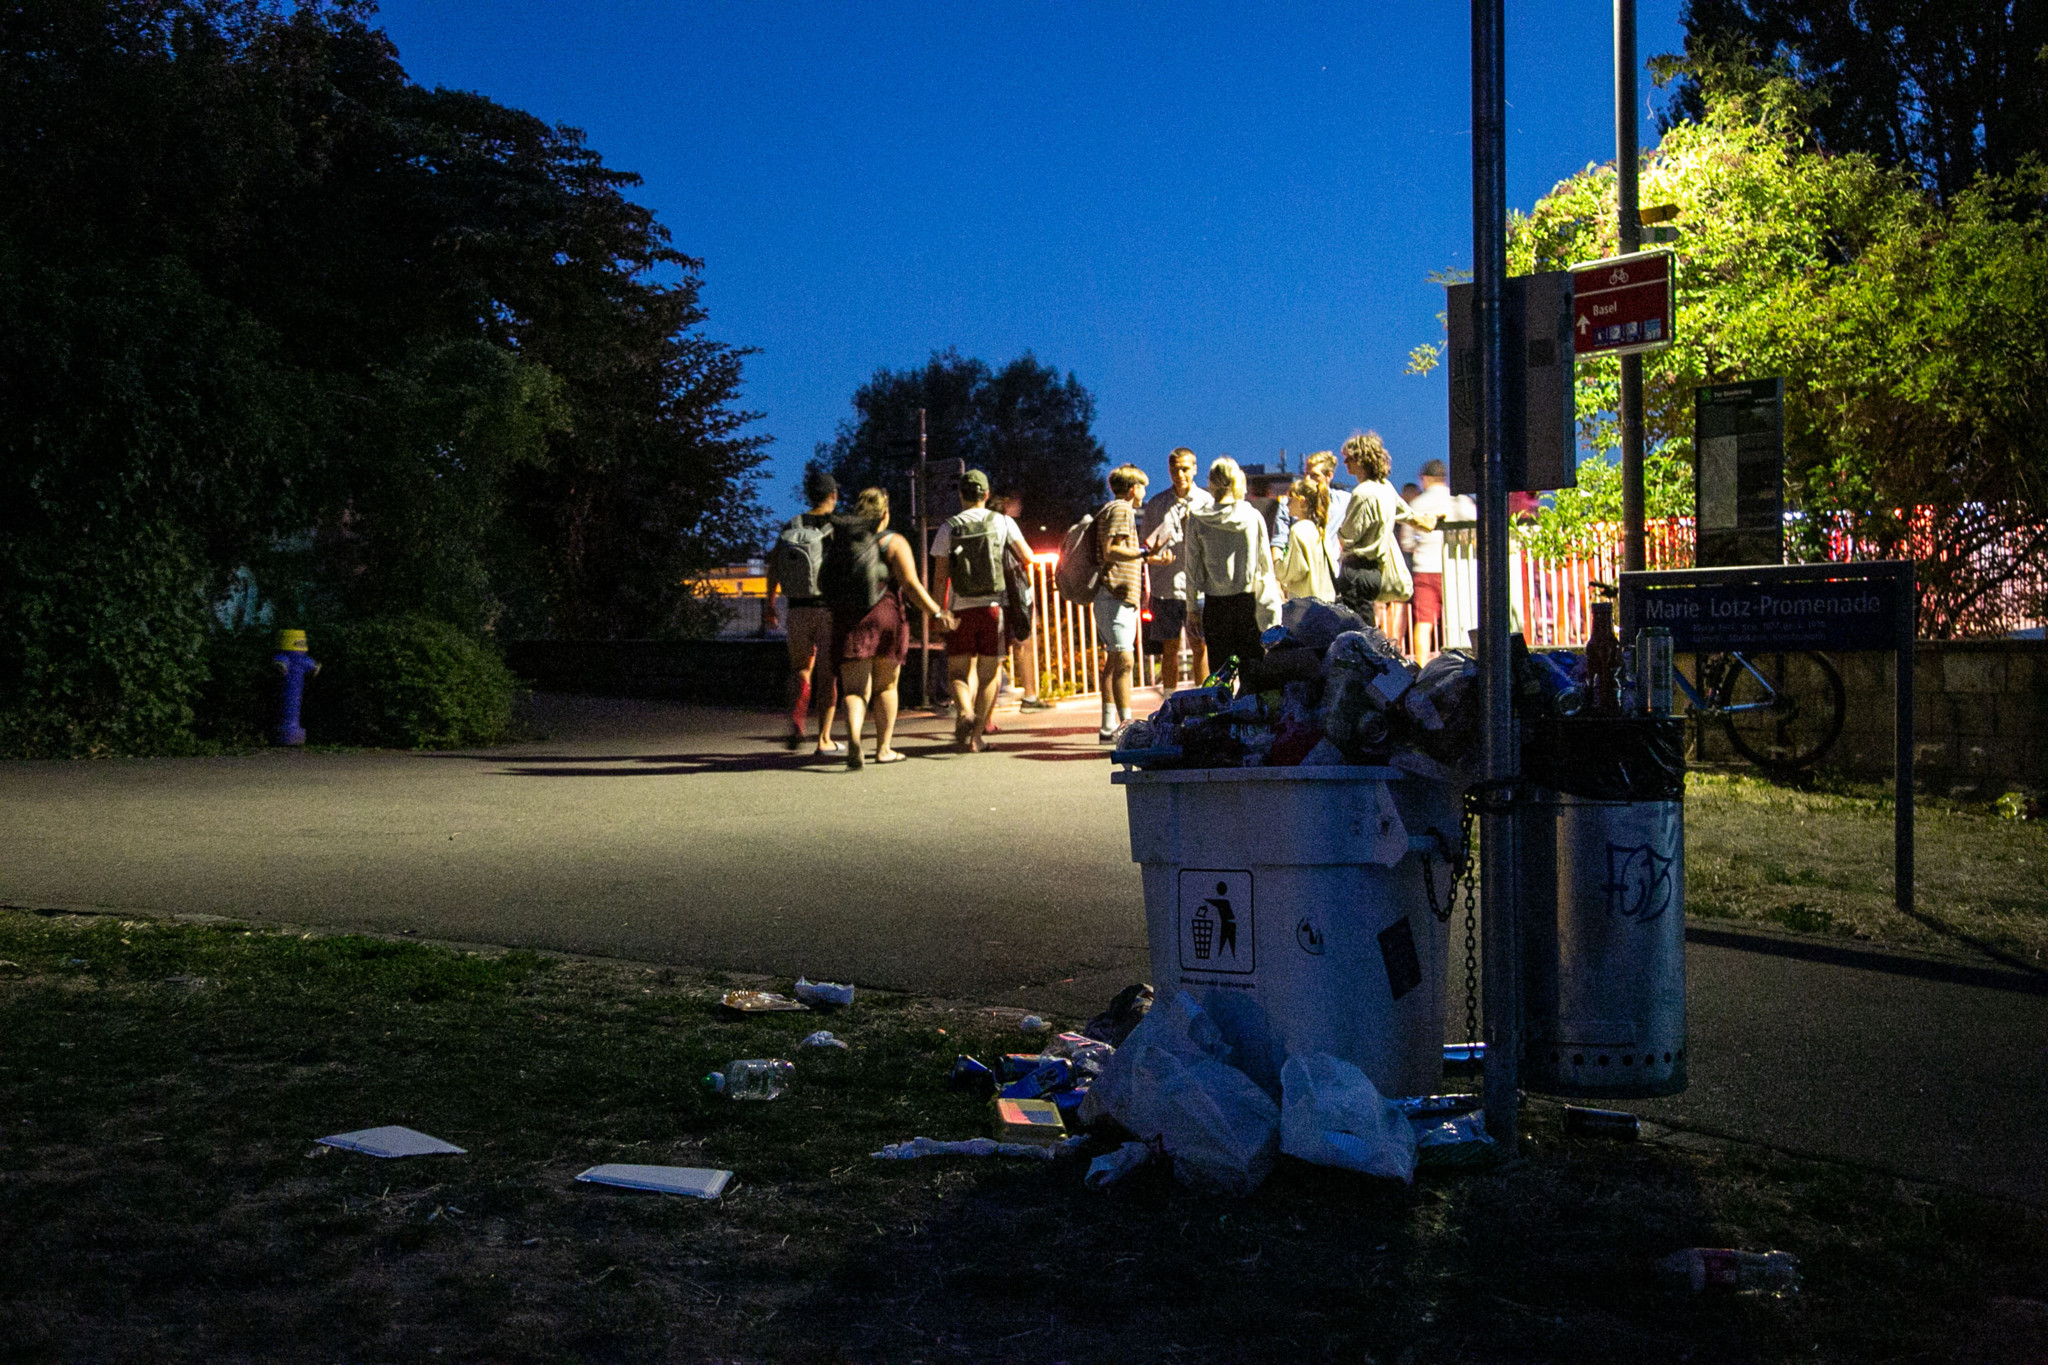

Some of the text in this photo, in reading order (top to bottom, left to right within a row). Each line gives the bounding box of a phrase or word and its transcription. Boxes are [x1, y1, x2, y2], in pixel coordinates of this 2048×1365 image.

[1592, 301, 1617, 317] Basel
[1645, 591, 1881, 620] Marie Lotz-Promenade
